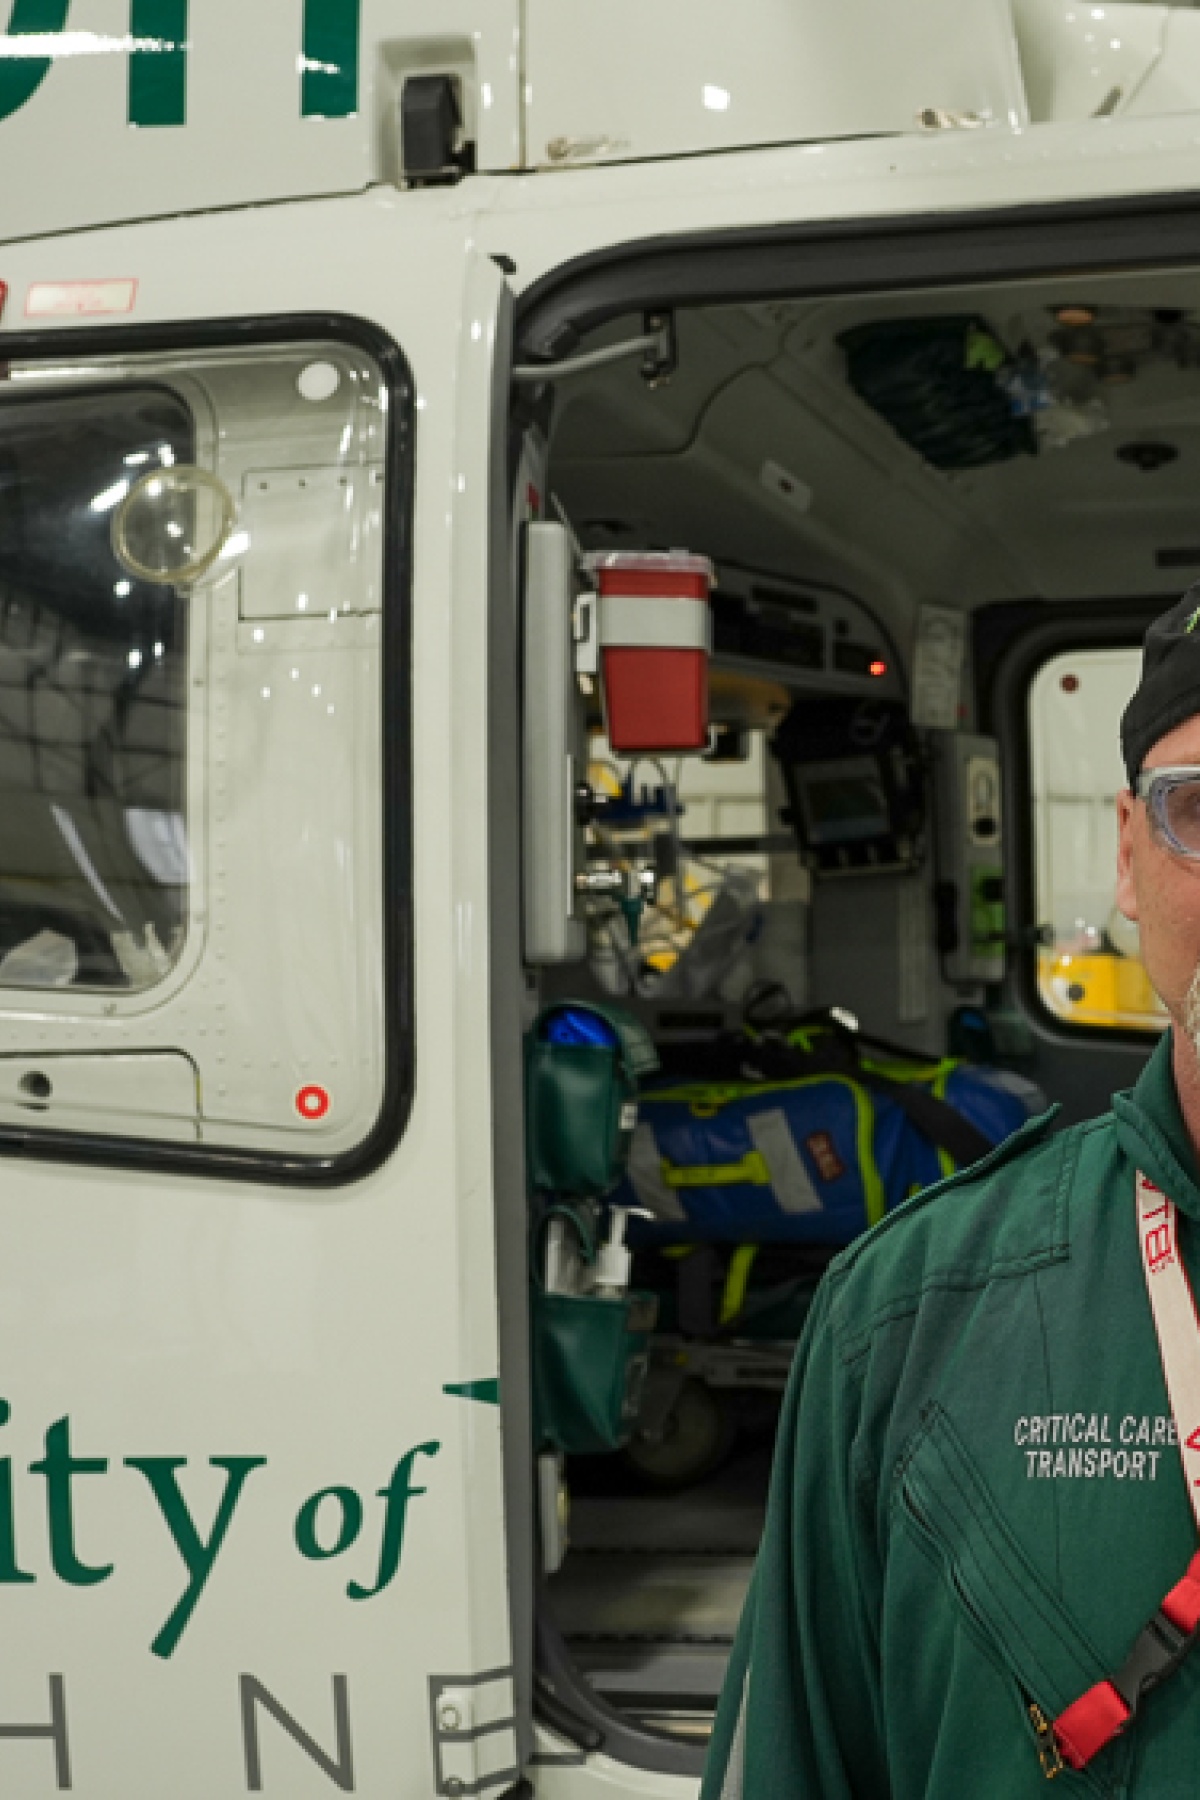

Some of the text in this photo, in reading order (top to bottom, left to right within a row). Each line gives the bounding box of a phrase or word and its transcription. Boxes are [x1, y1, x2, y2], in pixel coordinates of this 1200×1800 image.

[1014, 1412, 1179, 1446] CRITICAL CARE
[1025, 1448, 1162, 1481] TRANSPORT
[293, 1440, 441, 1601] of
